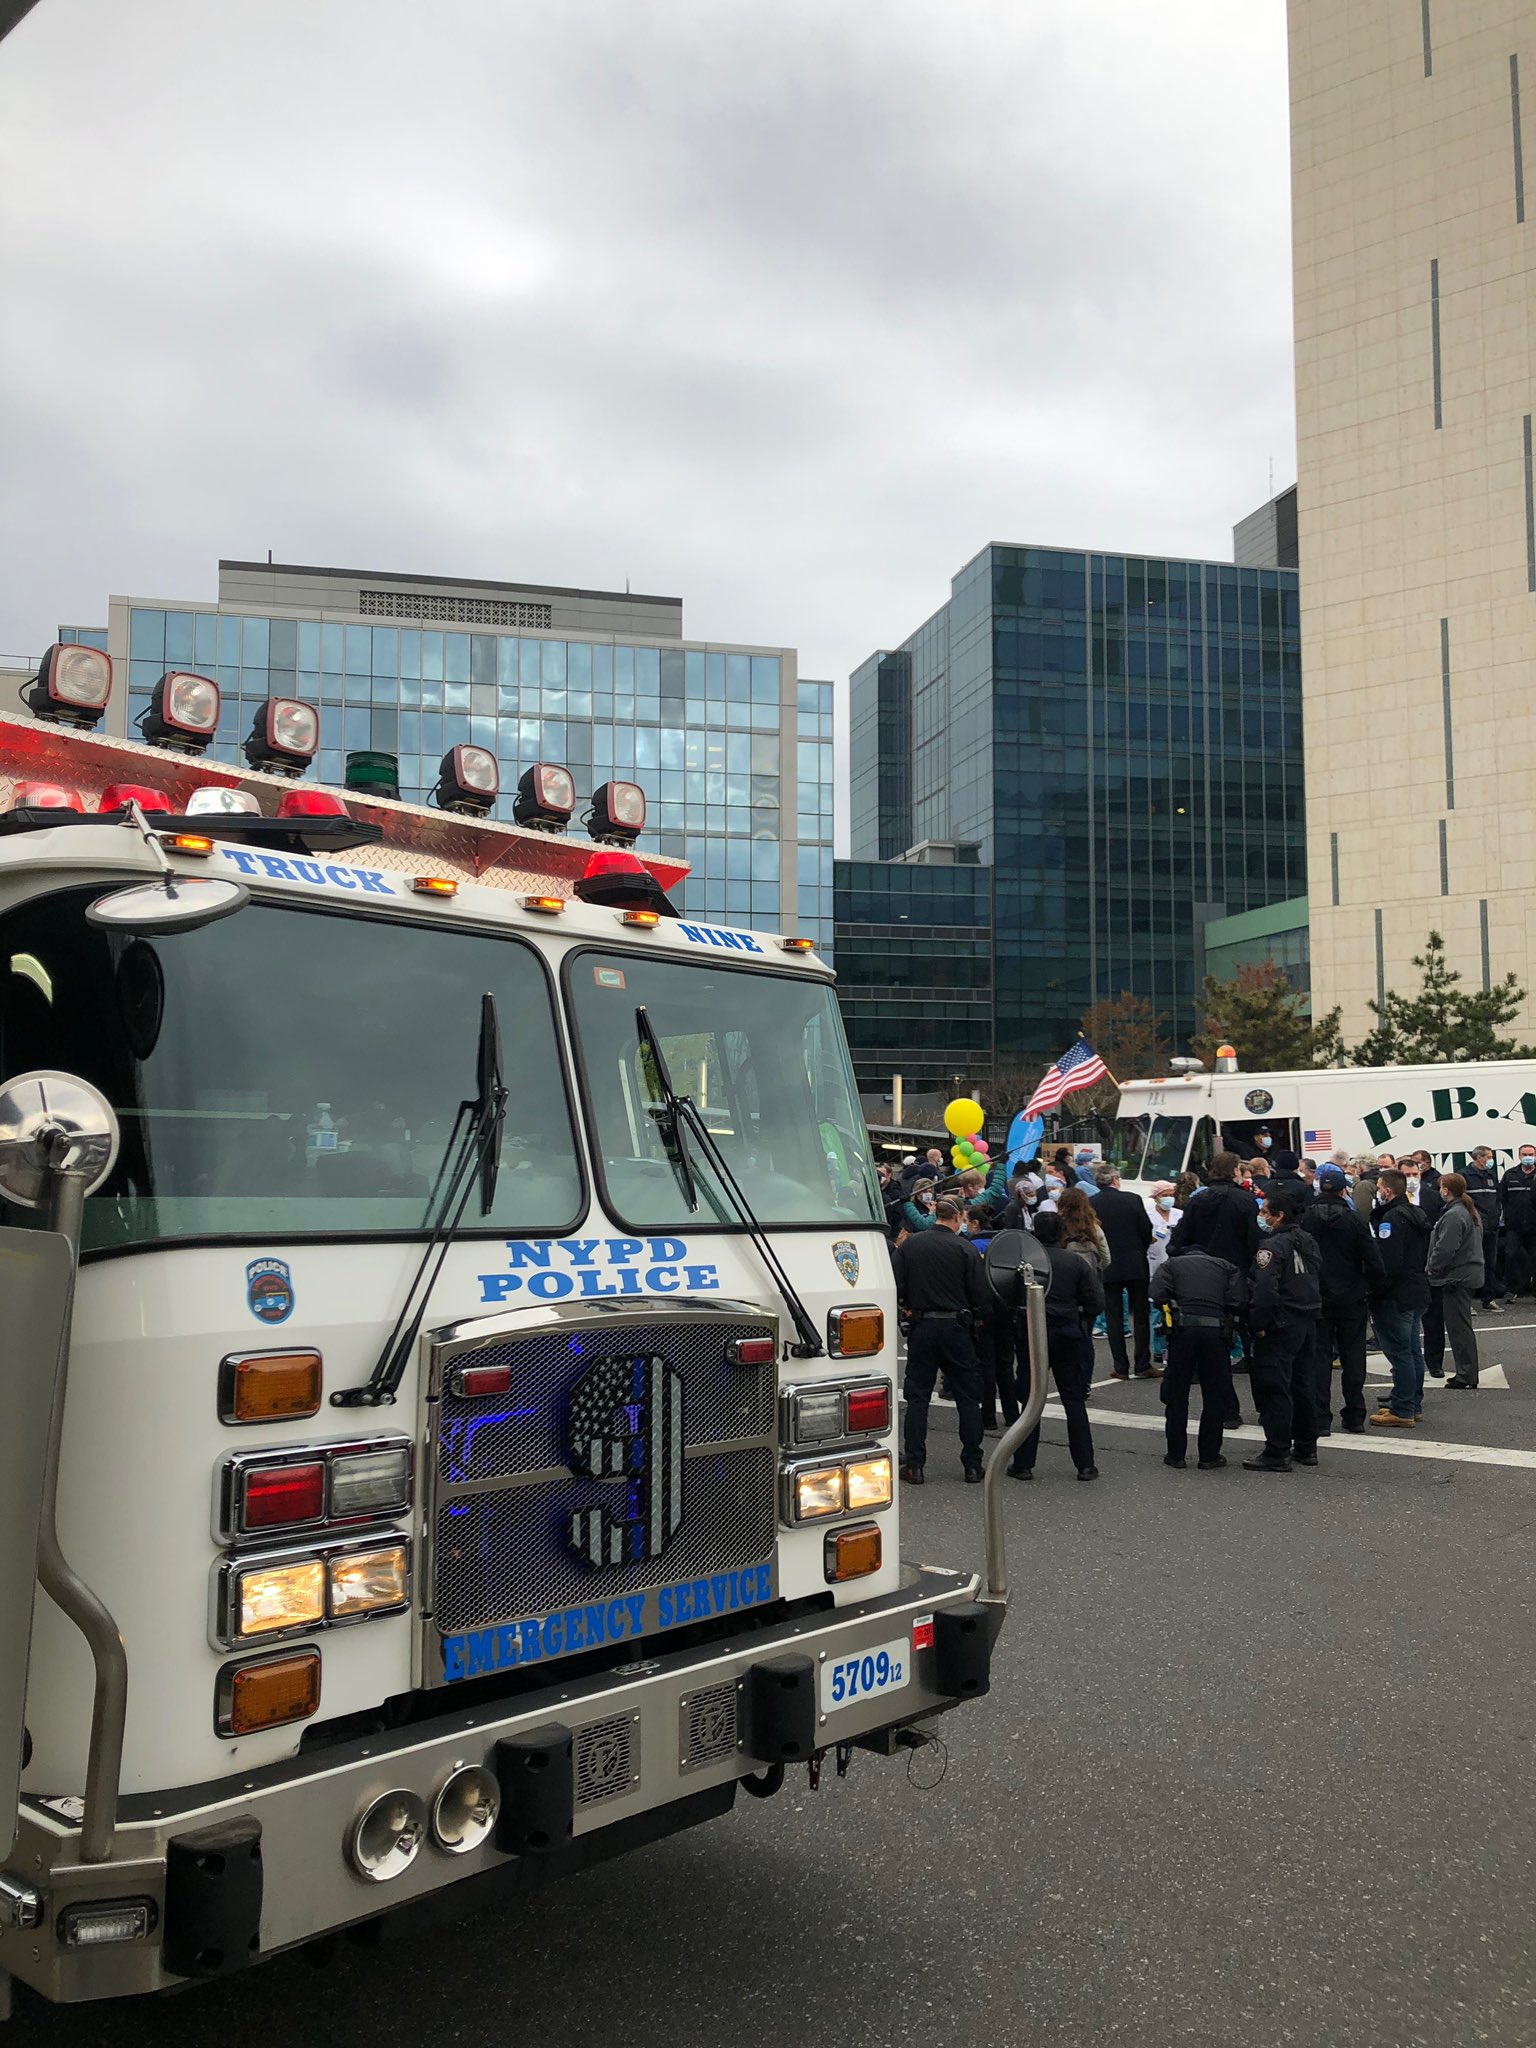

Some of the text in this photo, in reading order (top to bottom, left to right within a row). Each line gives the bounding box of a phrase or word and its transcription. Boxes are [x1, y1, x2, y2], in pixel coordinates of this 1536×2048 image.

[220, 849, 763, 953] TRUCK NINE
[506, 1237, 687, 1269] NYPD
[477, 1264, 720, 1303] POLICE
[443, 1563, 772, 1683] EMERGENCY SERVICE
[831, 1650, 890, 1702] 5709
